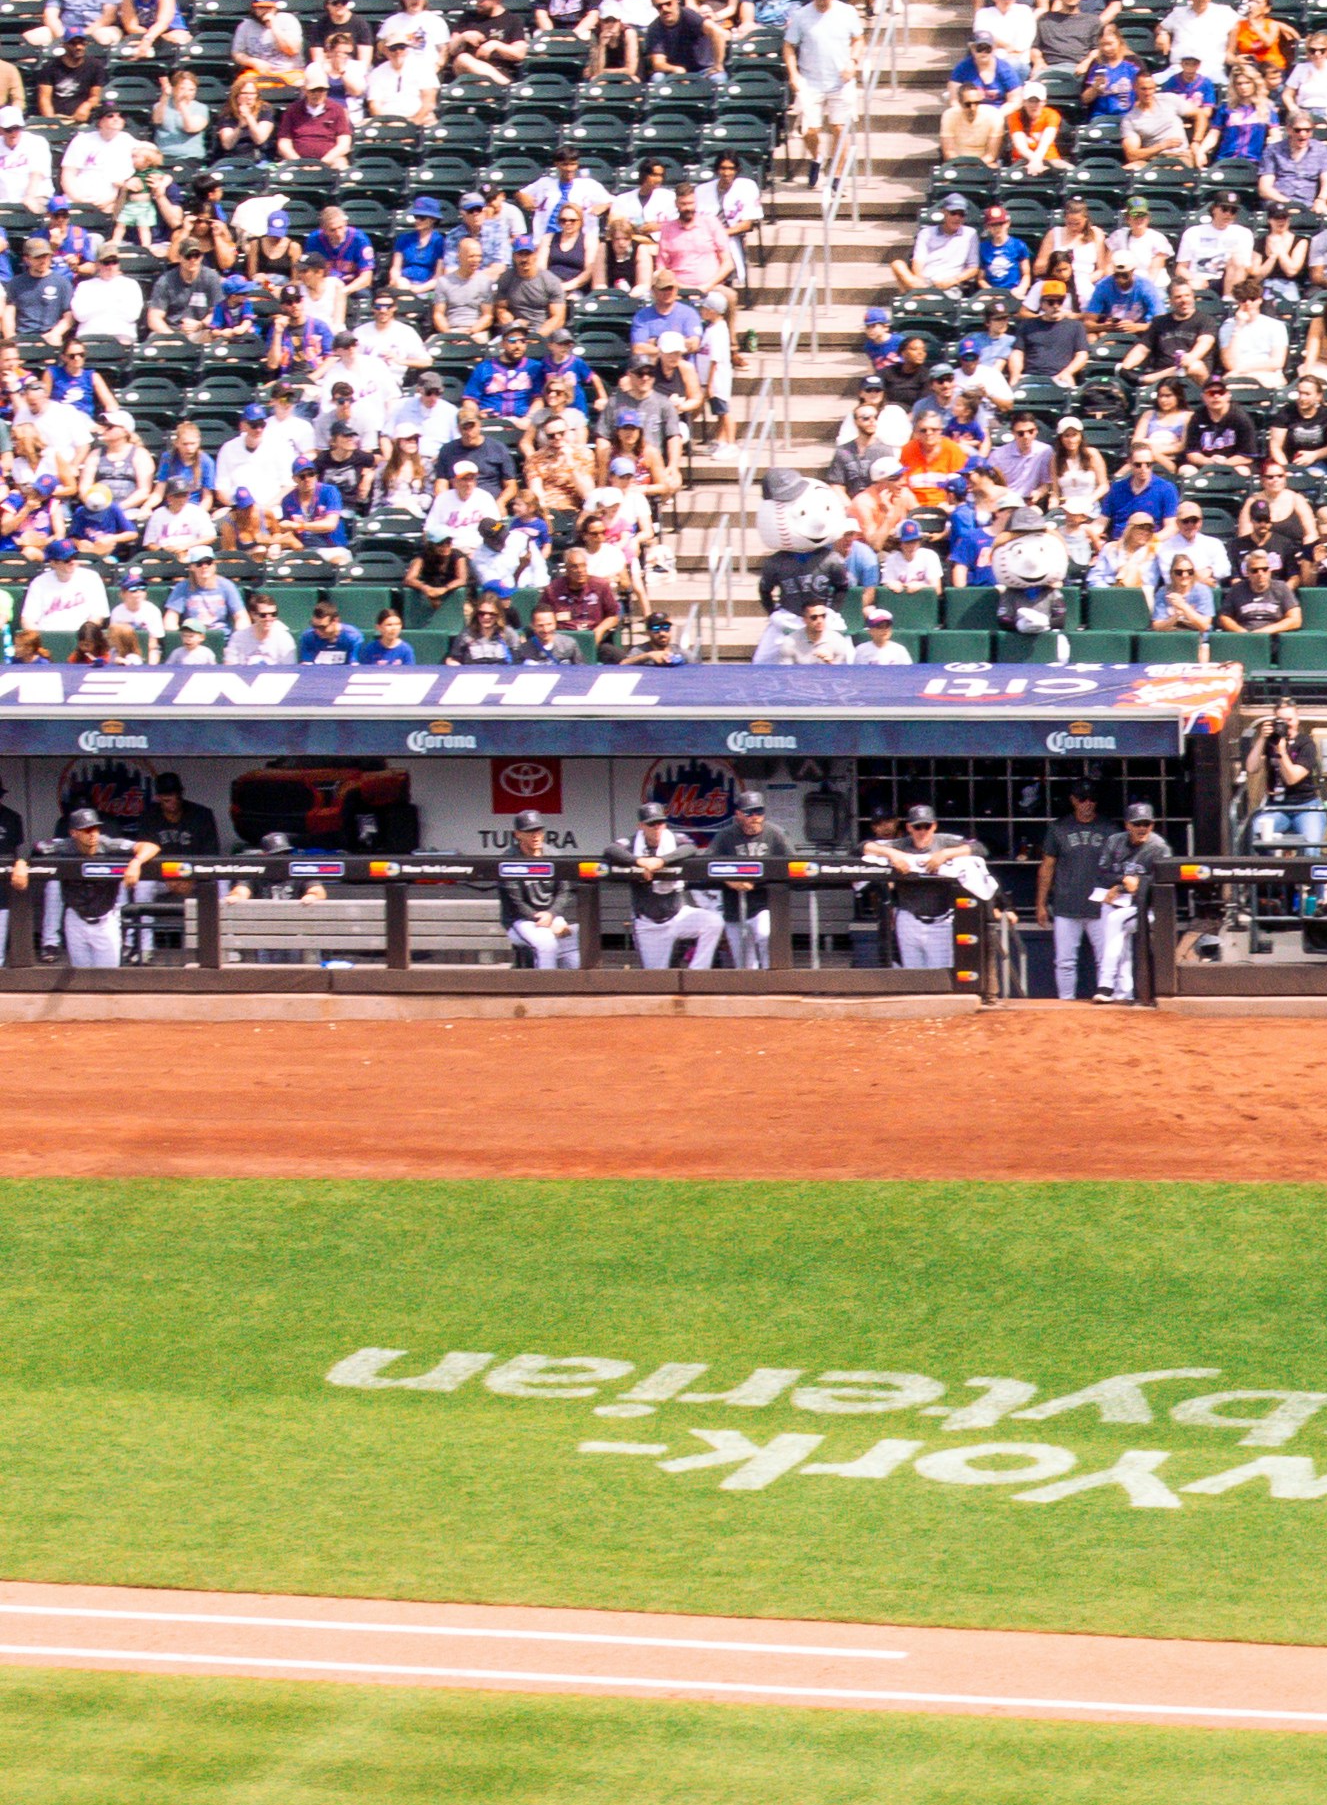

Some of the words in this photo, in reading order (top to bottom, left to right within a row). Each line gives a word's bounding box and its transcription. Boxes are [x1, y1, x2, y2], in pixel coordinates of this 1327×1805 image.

[333, 672, 660, 706] THE
[921, 677, 1099, 697] citi
[79, 731, 148, 753] Corona
[407, 731, 476, 753] Corona
[727, 731, 796, 753] Corona
[1047, 732, 1115, 754] Corona
[664, 783, 730, 818] Mets
[478, 829, 577, 850] TURA
